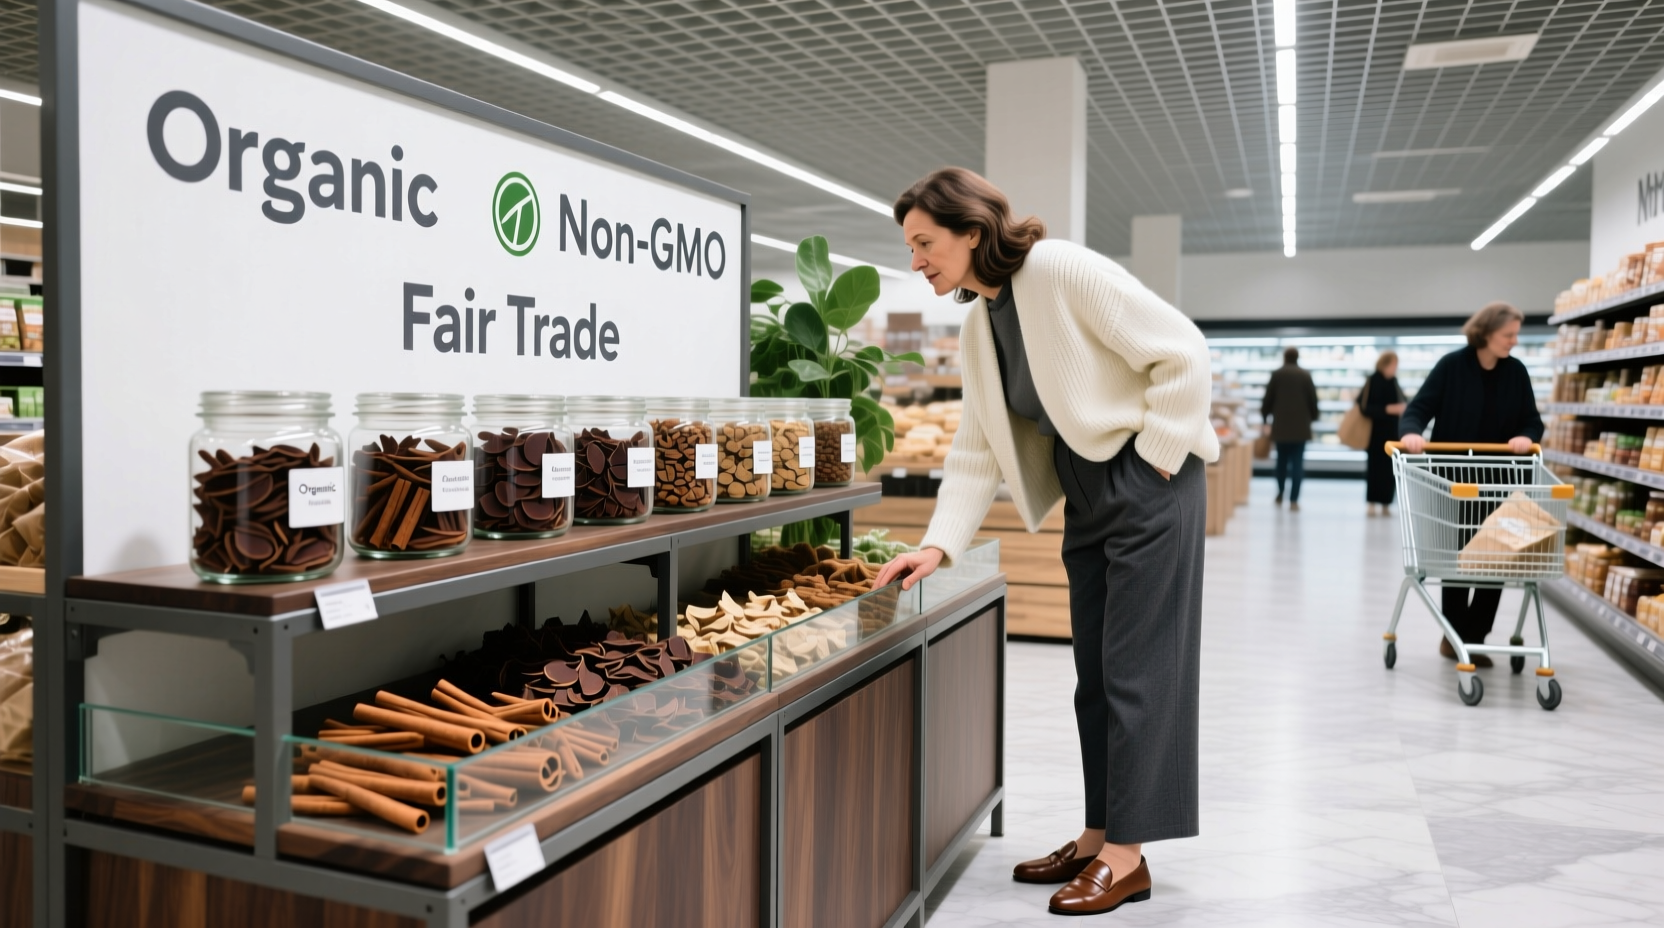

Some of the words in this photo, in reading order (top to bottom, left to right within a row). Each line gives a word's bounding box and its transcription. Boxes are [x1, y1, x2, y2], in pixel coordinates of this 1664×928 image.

[146, 90, 439, 228] Organic
[558, 193, 726, 280] Non-GMO
[403, 281, 497, 357] Fair
[506, 294, 620, 363] Trade
